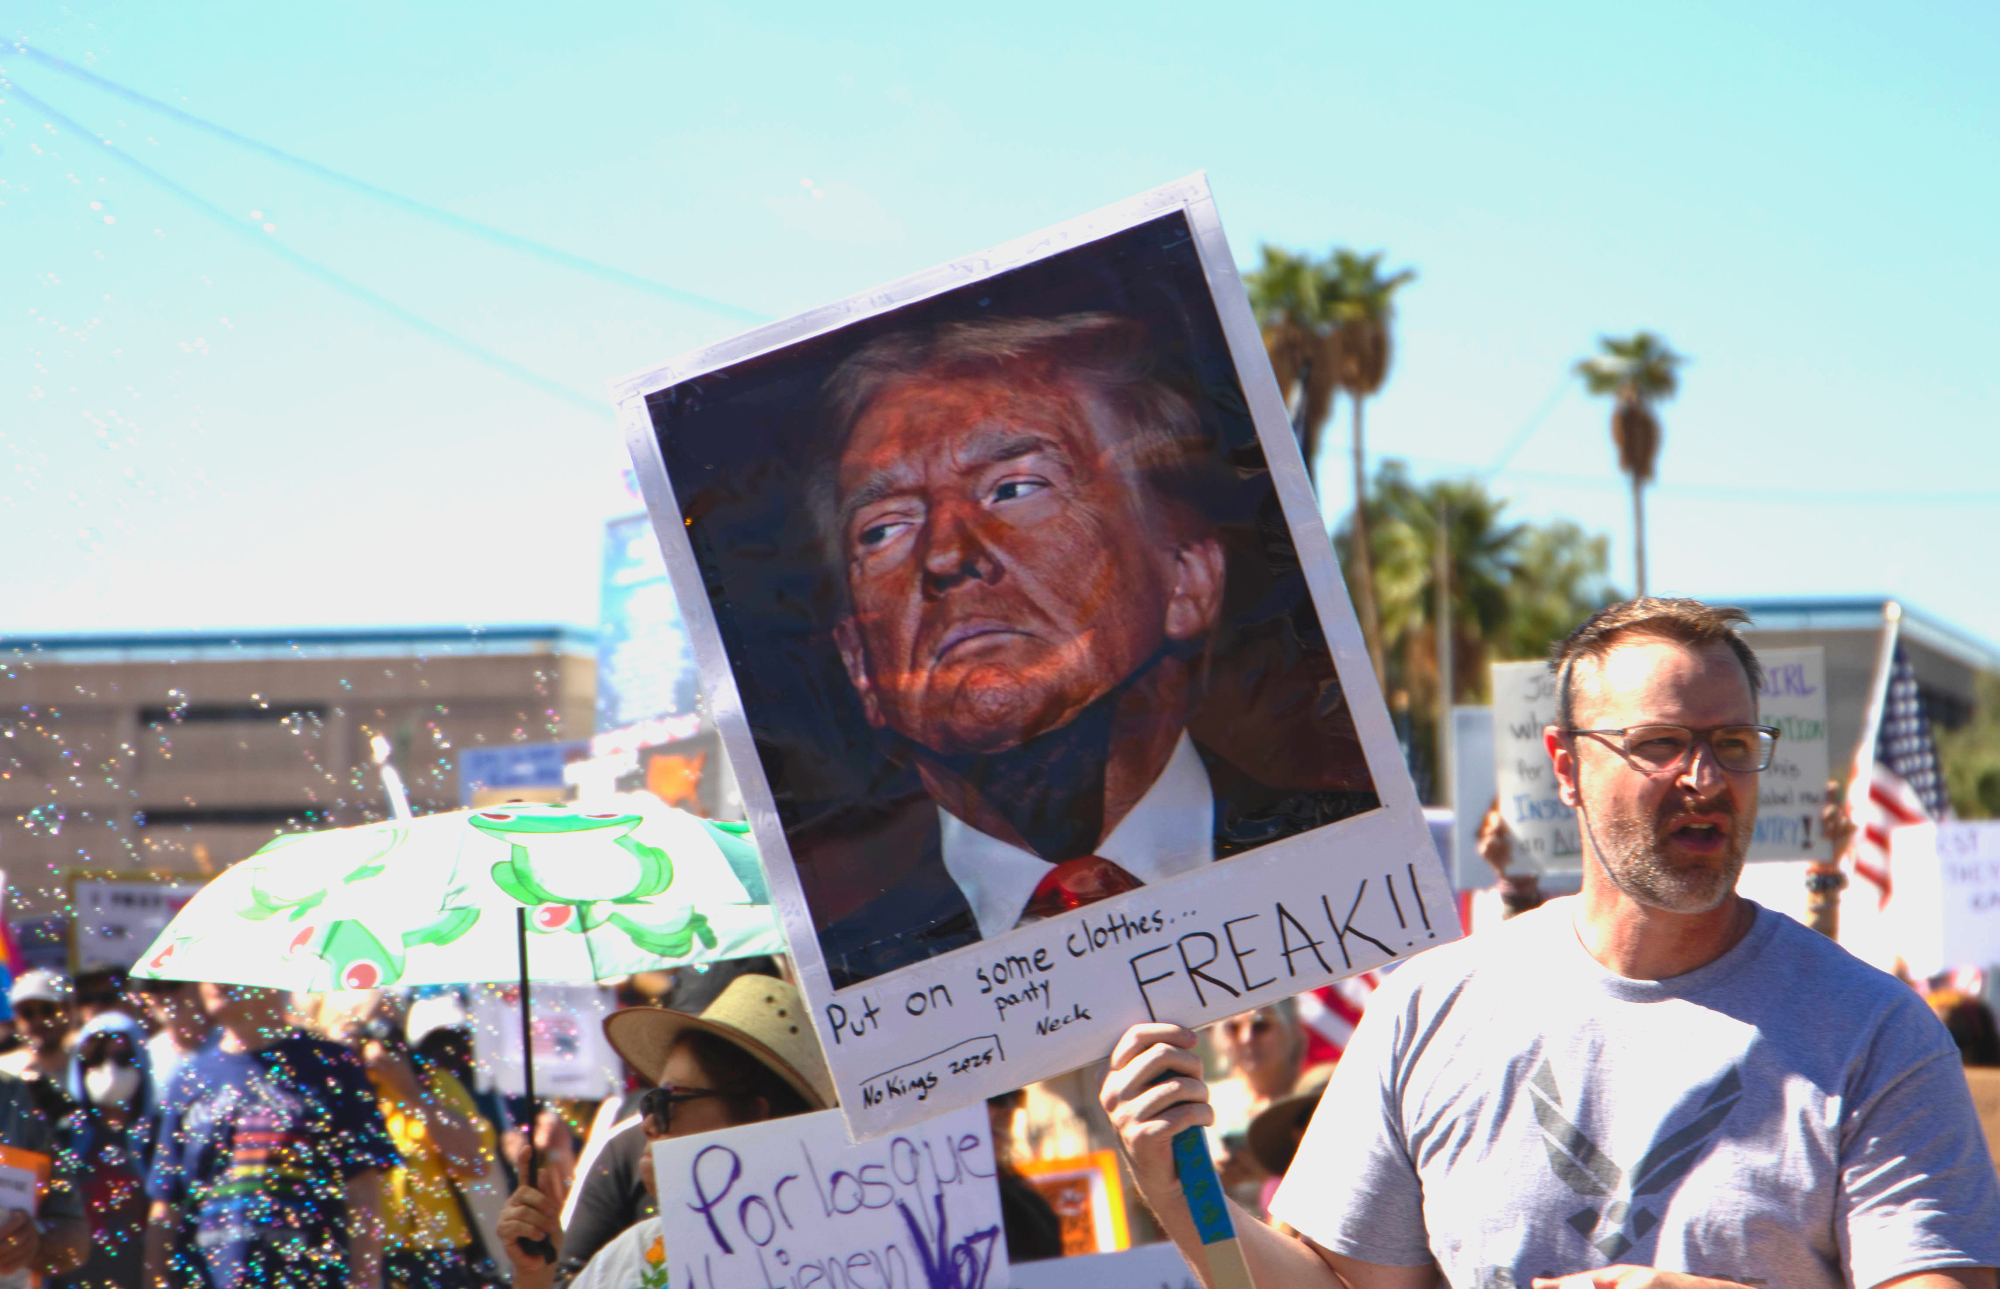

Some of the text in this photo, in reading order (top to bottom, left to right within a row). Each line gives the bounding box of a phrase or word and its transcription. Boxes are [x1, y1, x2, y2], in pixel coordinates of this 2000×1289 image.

[1129, 862, 1436, 1023] FREAK!!
[826, 995, 881, 1044] Put
[906, 984, 953, 1016] on
[977, 948, 1055, 994] some
[1036, 1003, 1093, 1036] Neck
[948, 1047, 995, 1075] 2025
